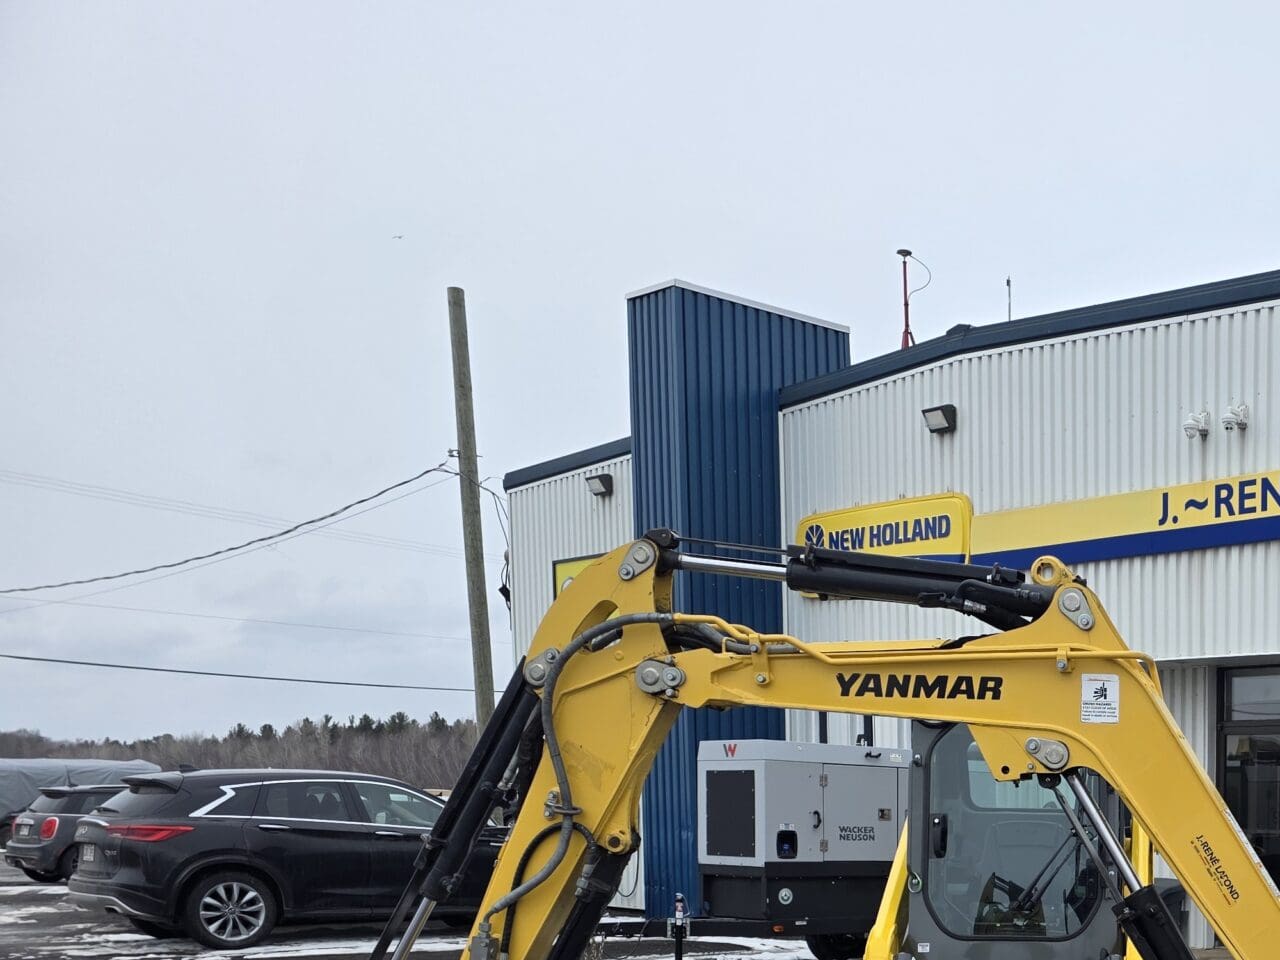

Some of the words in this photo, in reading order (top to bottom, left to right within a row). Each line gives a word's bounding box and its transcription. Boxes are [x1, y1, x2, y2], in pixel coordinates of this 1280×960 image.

[828, 526, 866, 551] NEW
[869, 514, 951, 548] HOLLAND
[835, 672, 1004, 701] YANMAR
[838, 826, 875, 834] WACKER
[839, 833, 876, 841] NEUSON
[1214, 865, 1240, 901] LAFOND
